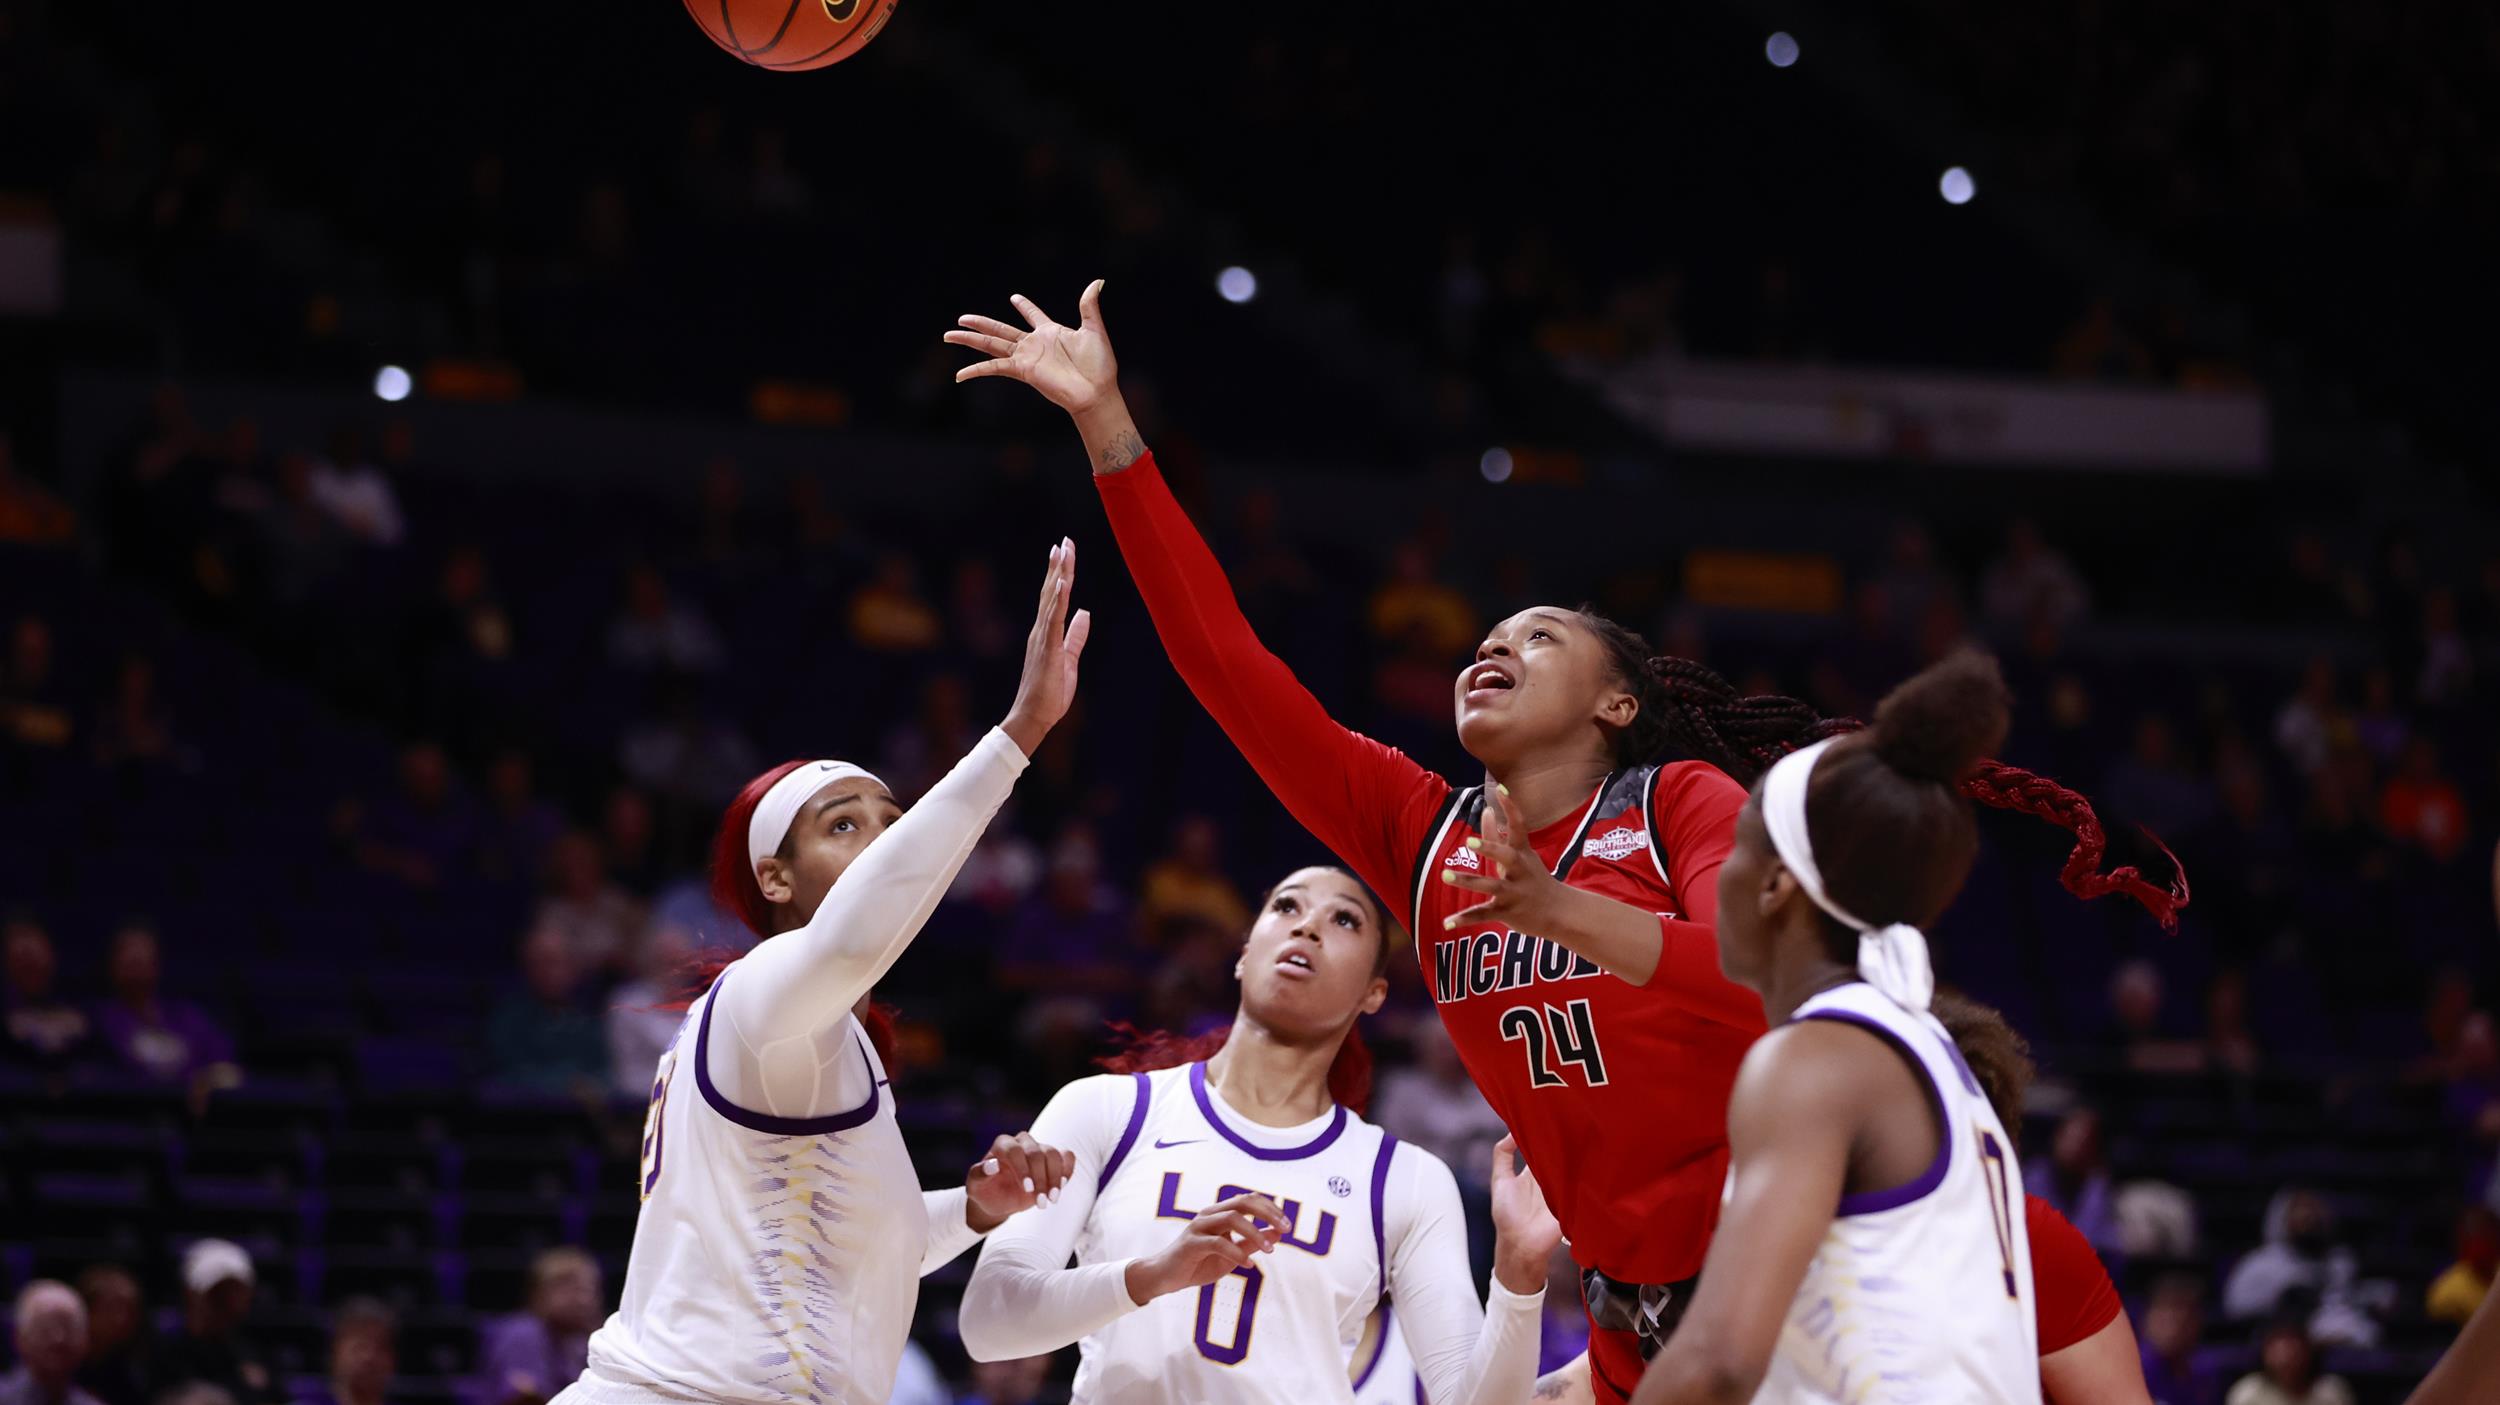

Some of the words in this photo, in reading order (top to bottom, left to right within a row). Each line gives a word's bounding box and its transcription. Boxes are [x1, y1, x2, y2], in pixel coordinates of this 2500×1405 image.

[1445, 856, 1480, 870] adida
[1500, 998, 1610, 1090] 24
[1194, 1263, 1264, 1368] 0
